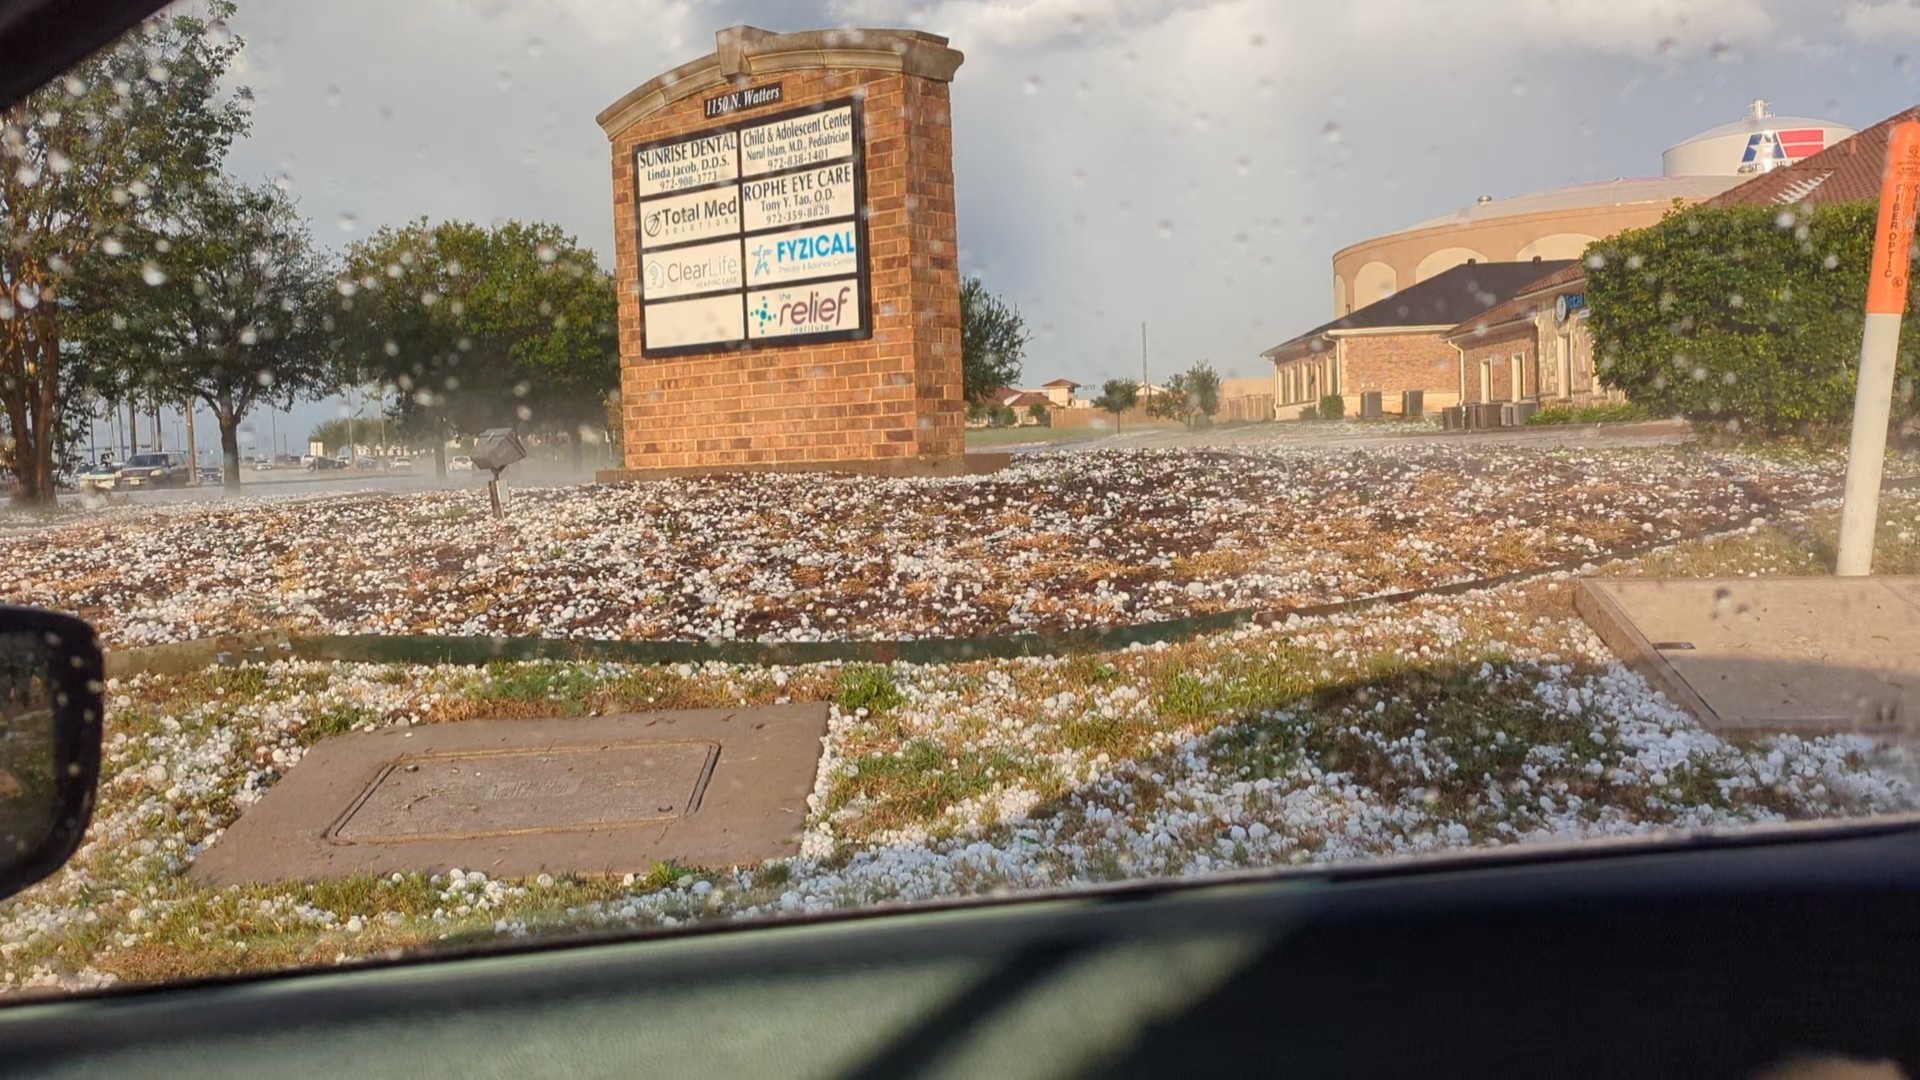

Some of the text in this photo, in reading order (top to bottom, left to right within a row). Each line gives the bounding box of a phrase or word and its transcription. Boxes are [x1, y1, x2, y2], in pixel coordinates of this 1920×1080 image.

[706, 87, 779, 115] 1150 N. Watters
[743, 112, 851, 148] Child & Adolescent Center
[808, 129, 850, 149] Pediatrician
[640, 133, 736, 169] SUNRISE DENTAL
[768, 148, 829, 169] 972-838-1401
[647, 155, 730, 181] Linda Jacob, D.D.S.
[743, 165, 851, 202] ROPHE EYE CARE
[662, 196, 737, 226] Total Med
[761, 188, 835, 213] Tony Y. Tao, O.D.
[665, 216, 737, 236] SOLUTIONS
[766, 204, 830, 225] 972-359-8828
[777, 231, 855, 263] FYZICAL
[667, 255, 737, 283] ClearLife
[779, 292, 791, 301] the
[779, 286, 851, 327] relief
[790, 323, 830, 334] institute
